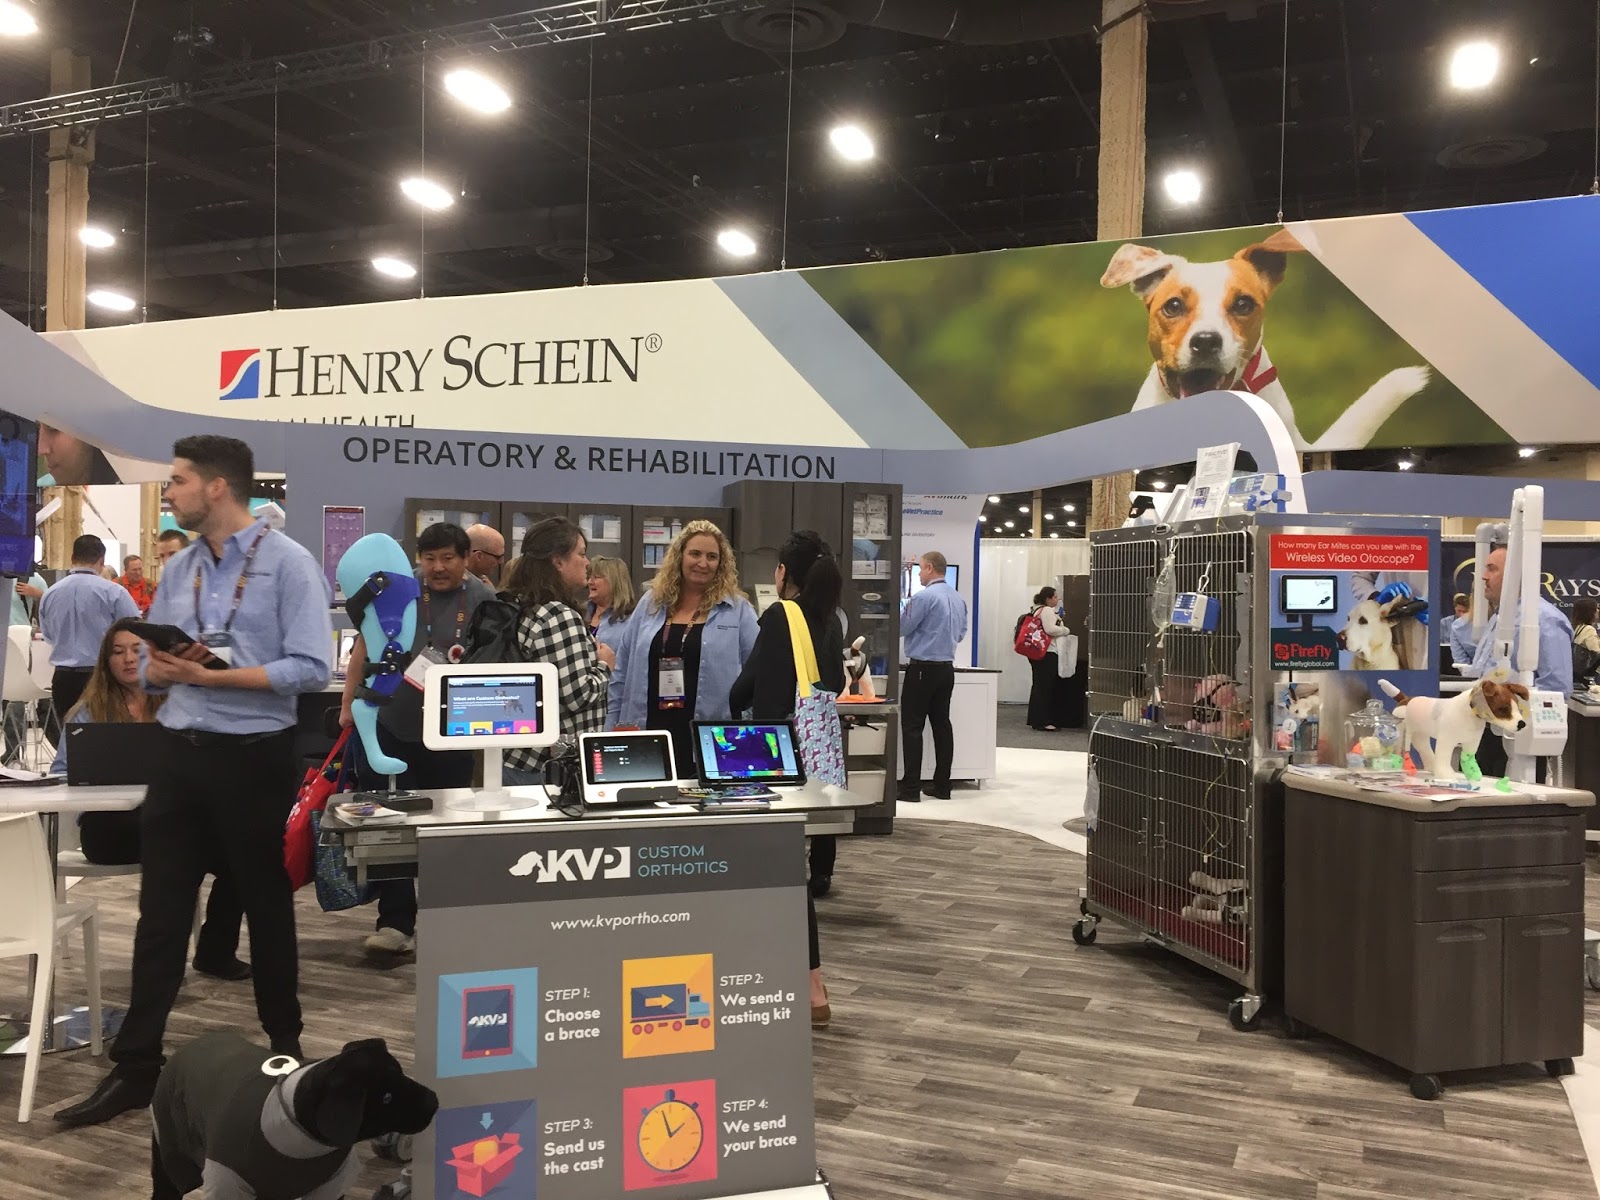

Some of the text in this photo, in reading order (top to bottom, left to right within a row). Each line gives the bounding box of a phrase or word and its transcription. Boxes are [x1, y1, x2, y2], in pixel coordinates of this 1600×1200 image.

[265, 346, 433, 398] HENRY
[343, 437, 836, 480] OPERATORY & REHABILITATION
[1278, 541, 1294, 549] How
[1296, 542, 1316, 550] many
[1318, 541, 1329, 549] Ear
[1331, 541, 1349, 549] Mites
[1411, 543, 1422, 551] the
[1286, 552, 1415, 566] Wireless Video Otoscope?
[1290, 643, 1332, 660] Firefly
[638, 845, 705, 860] CUSTOM
[638, 861, 728, 878] ORTHOTICS
[551, 911, 690, 931] www.kvportho.com
[720, 973, 764, 987] STEP 2:
[545, 988, 580, 1002] STEP
[721, 992, 795, 1007] We send a
[545, 1009, 600, 1023] Choose
[720, 1006, 791, 1026] casting kit
[545, 1027, 600, 1042] a brace
[723, 1098, 769, 1114] STEP 4:
[544, 1118, 593, 1135] STEP 3:
[723, 1115, 786, 1134] We send
[544, 1140, 605, 1157] Send us
[724, 1135, 798, 1158] your brace
[544, 1157, 604, 1176] the cast
